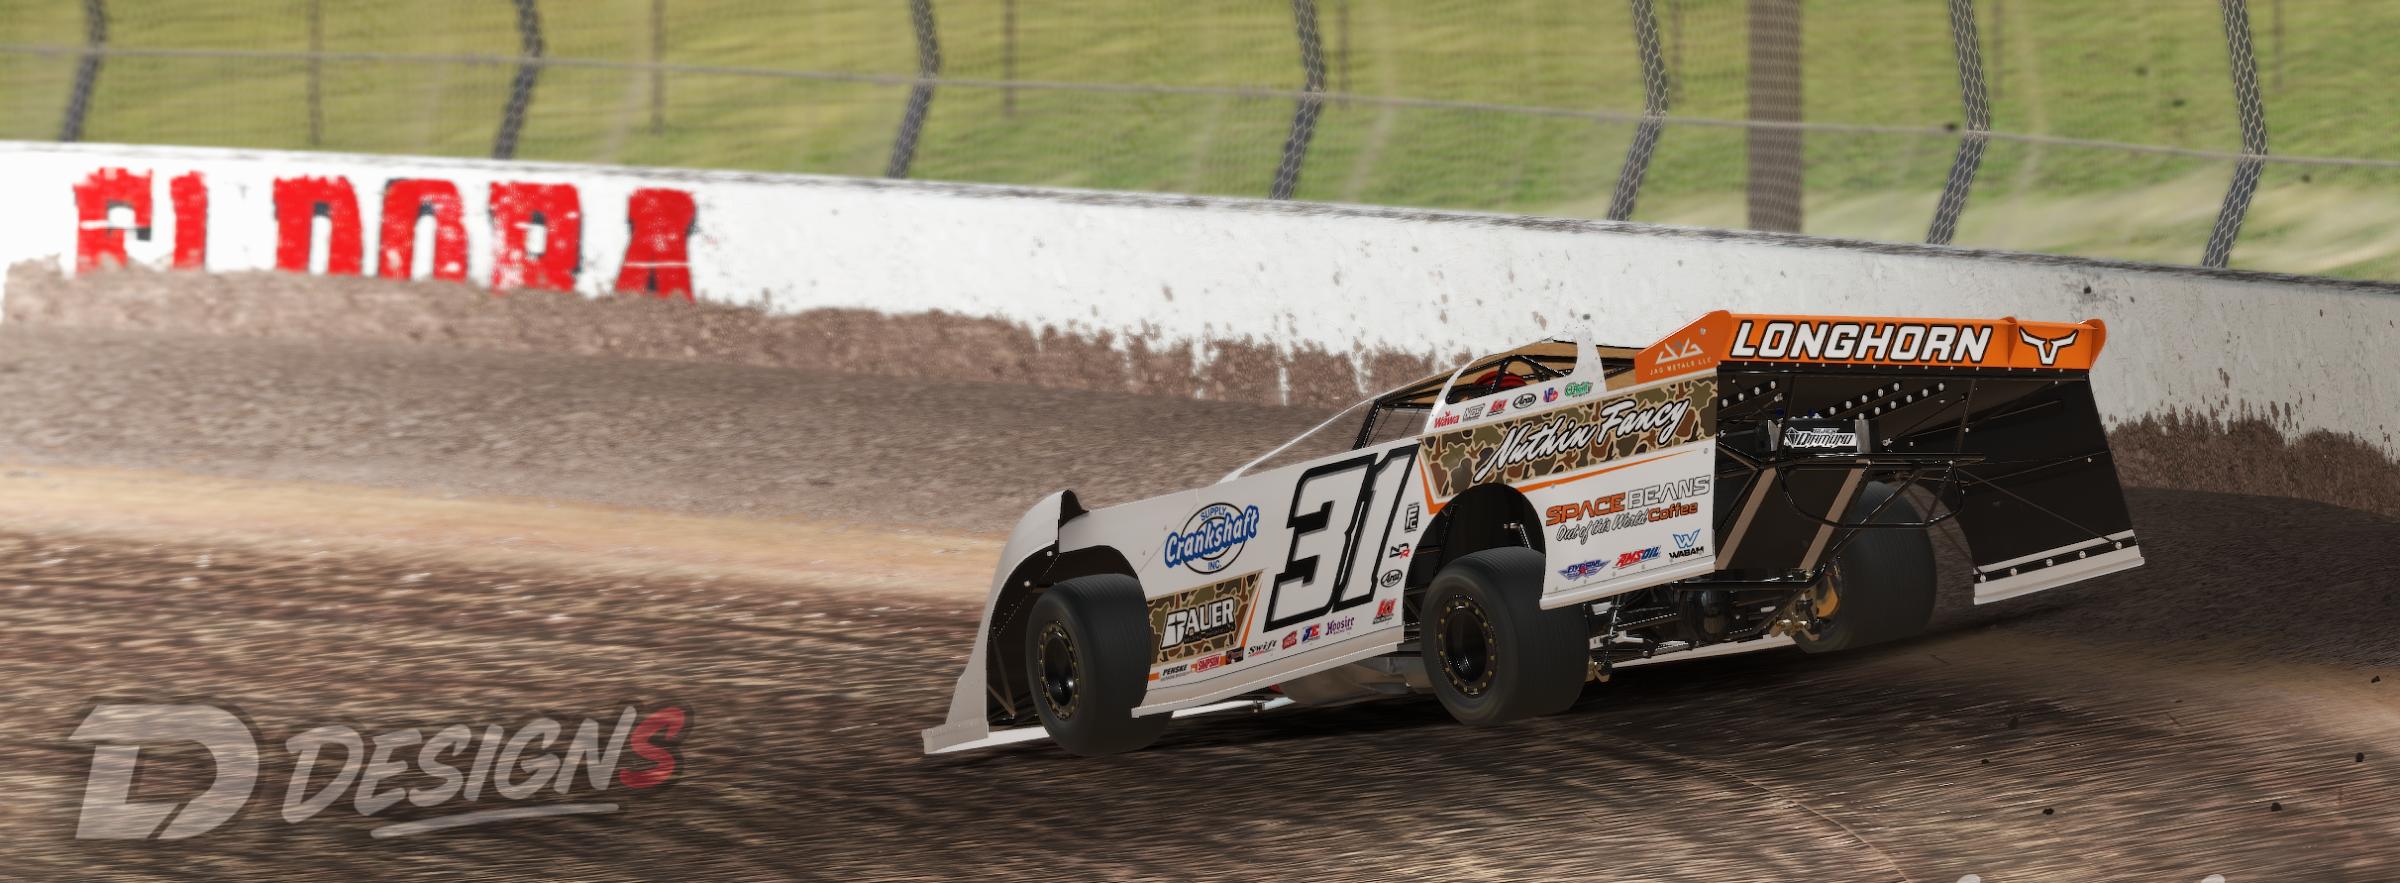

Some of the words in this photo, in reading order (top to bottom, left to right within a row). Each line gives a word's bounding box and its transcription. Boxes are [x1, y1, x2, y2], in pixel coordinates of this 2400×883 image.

[1730, 320, 1995, 364] LONGHORN
[1434, 414, 1460, 429] Wawa
[1473, 416, 1597, 483] Nuthin
[1596, 399, 1692, 445] Fancy
[1200, 506, 1227, 521] SUPPLY
[1546, 492, 1626, 526] SPACE
[1627, 475, 1711, 509] BEANS
[1165, 505, 1259, 568] Crankshaft
[1263, 442, 1421, 633] 31
[1556, 524, 1580, 541] Out
[1579, 520, 1593, 545] of
[1611, 508, 1649, 530] World
[1648, 502, 1698, 522] Coffee
[1207, 560, 1222, 571] INC.
[1615, 546, 1661, 568] AMSOIL
[1160, 597, 1236, 650] BAUER
[1325, 616, 1355, 636] Hoosier
[1248, 640, 1277, 654] Swift
[1162, 664, 1188, 676] PENSKE
